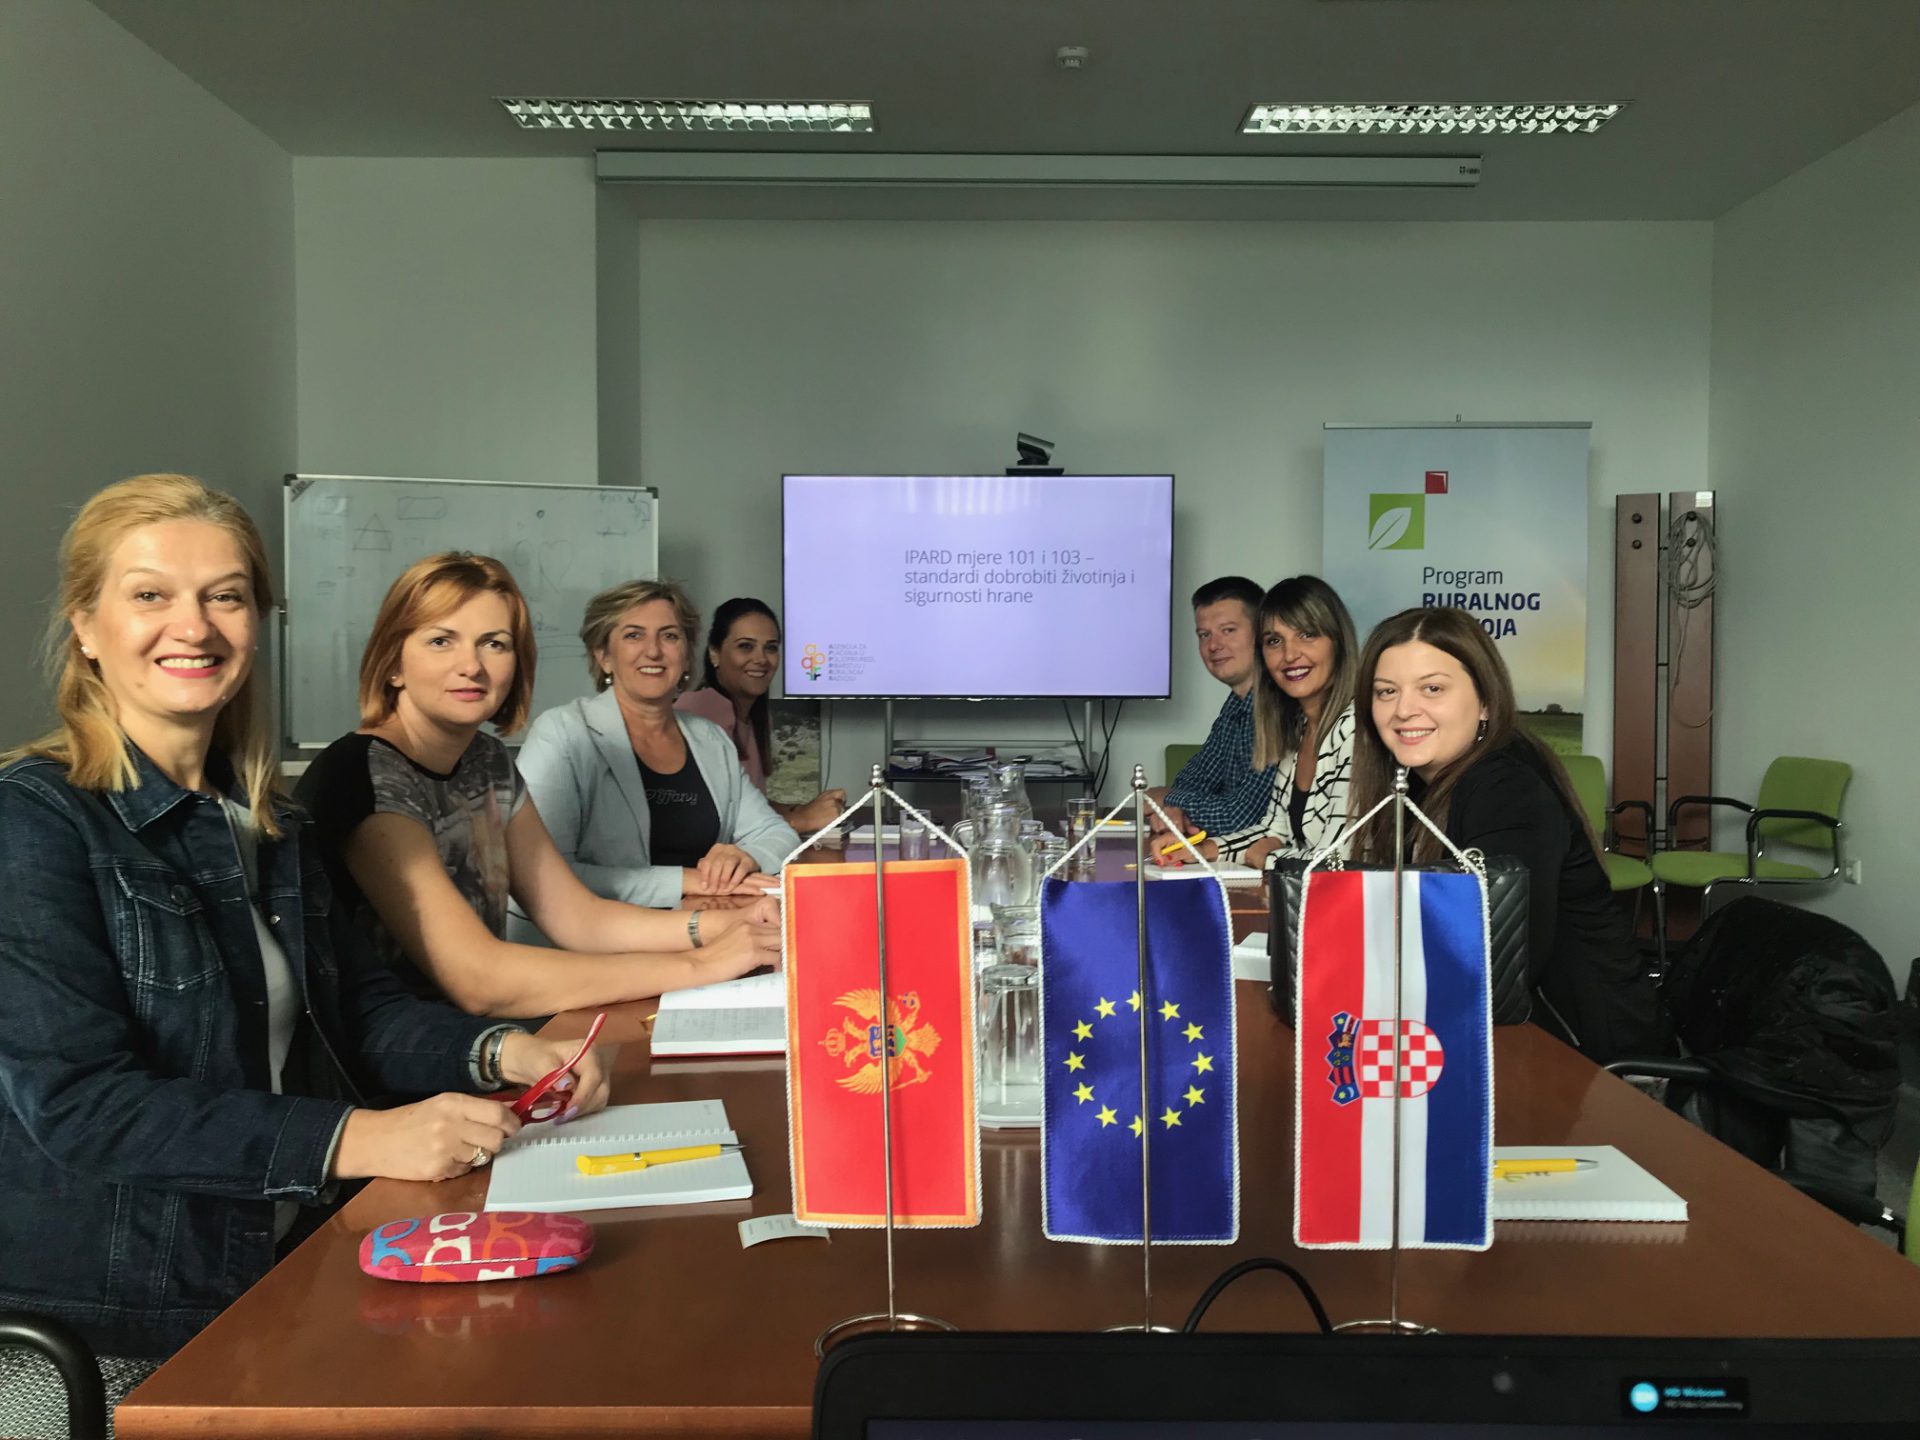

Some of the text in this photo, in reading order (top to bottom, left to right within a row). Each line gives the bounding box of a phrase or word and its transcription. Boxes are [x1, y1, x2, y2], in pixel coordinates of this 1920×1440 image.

[904, 550, 952, 565] IPARD
[957, 550, 1003, 568] mjere
[1008, 550, 1035, 565] 101
[1041, 550, 1046, 565] i
[1052, 550, 1081, 565] 103
[904, 568, 1135, 588] standardi dobrobiti životinja i
[1423, 566, 1503, 589] Program
[904, 588, 1033, 607] sigurnosti hrane
[1422, 592, 1541, 611] RURALNOG
